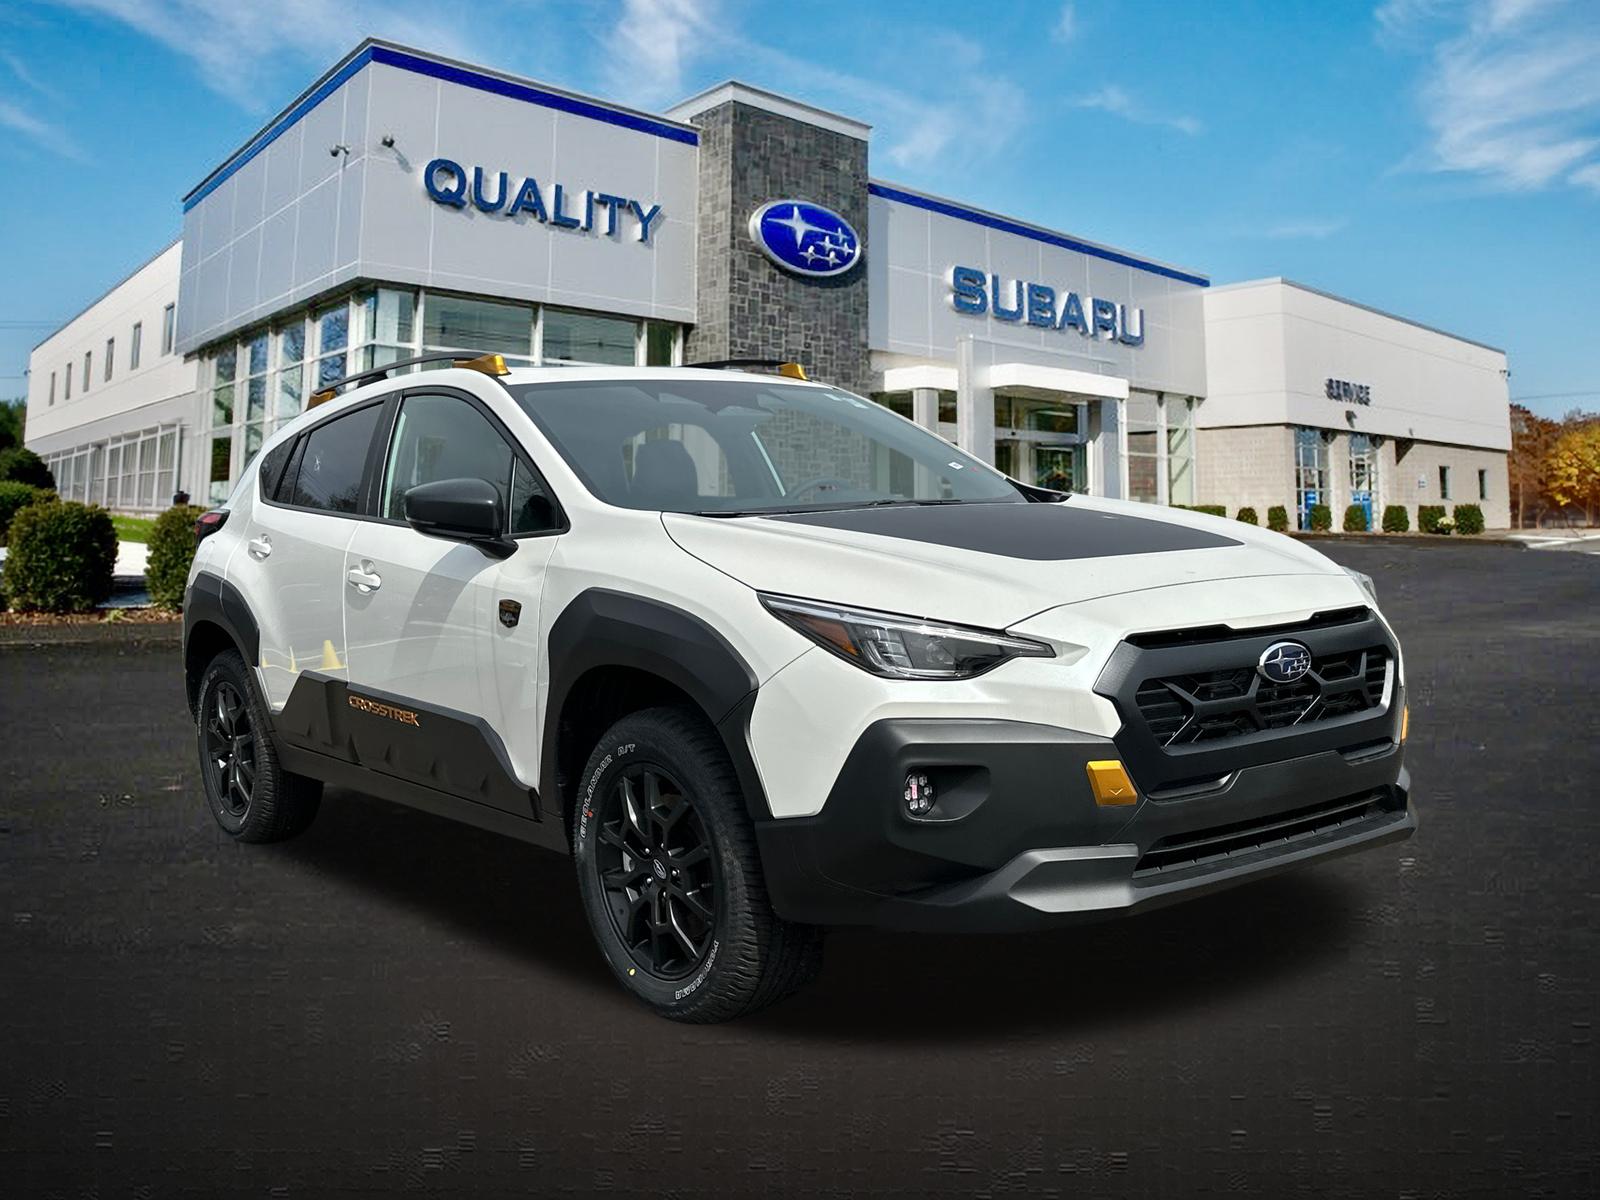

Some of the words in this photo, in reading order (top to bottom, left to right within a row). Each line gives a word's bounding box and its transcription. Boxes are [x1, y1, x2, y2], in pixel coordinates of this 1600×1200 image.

[424, 158, 661, 242] QUALITY
[951, 265, 1145, 346] SUBARU
[348, 695, 420, 727] CROSSTREK
